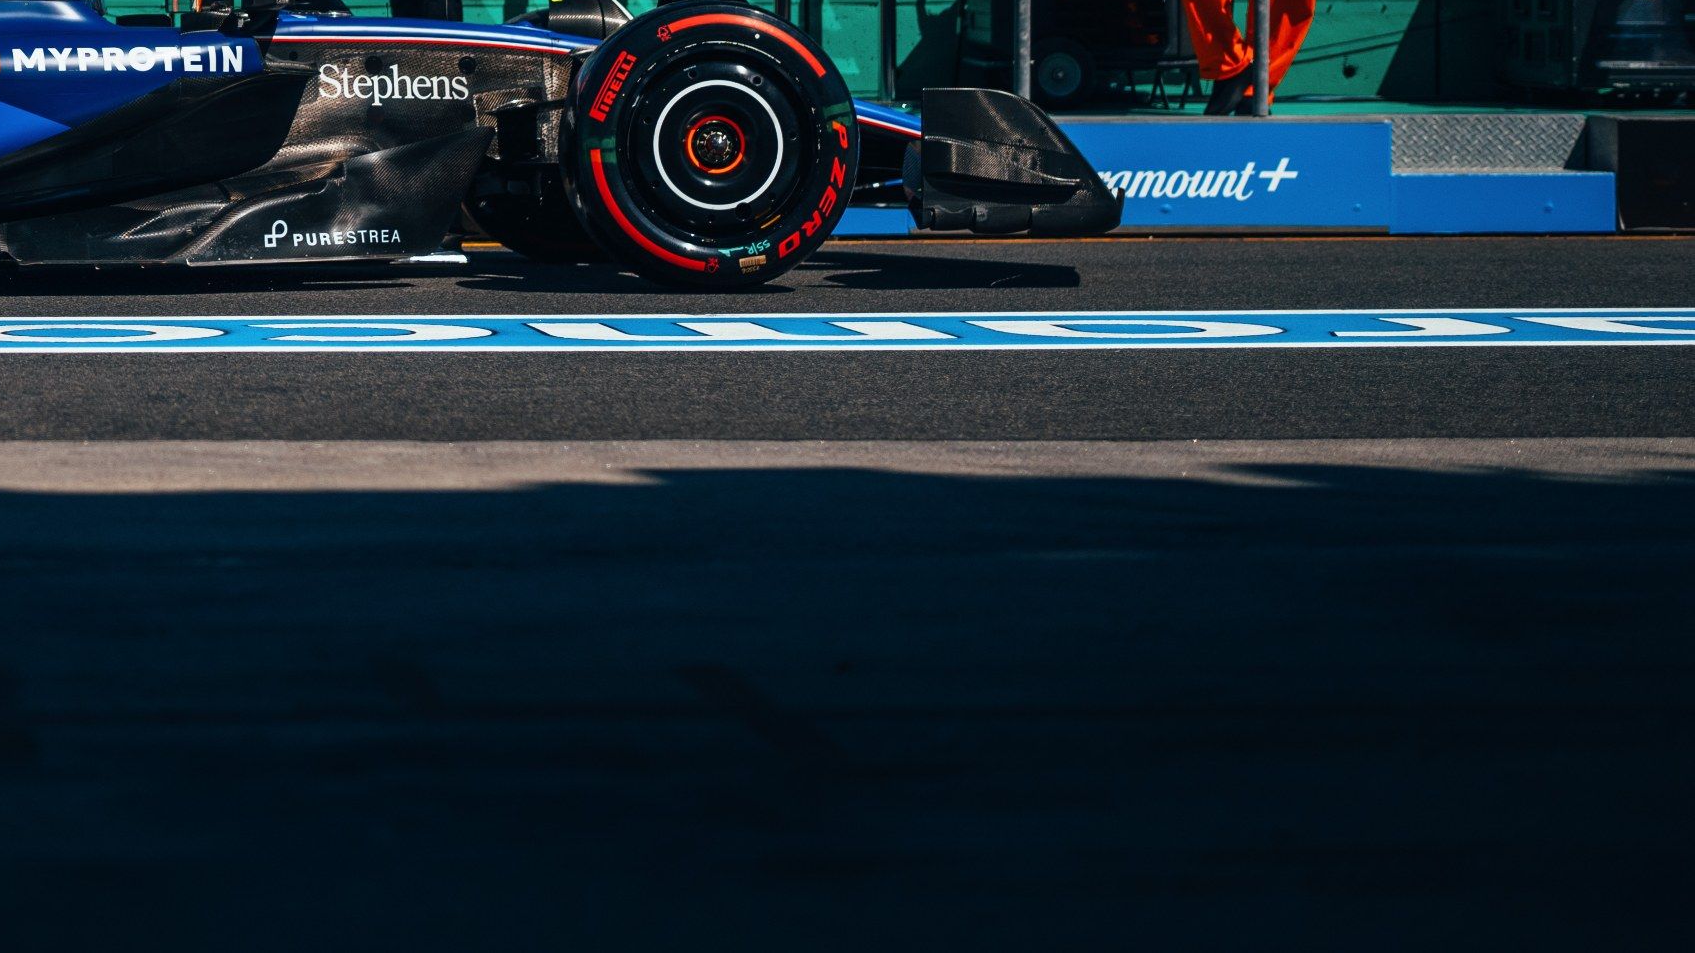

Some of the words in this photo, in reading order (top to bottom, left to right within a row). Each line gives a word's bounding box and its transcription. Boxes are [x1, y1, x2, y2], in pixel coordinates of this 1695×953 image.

[13, 45, 243, 73] MYPROTEIN
[318, 63, 469, 106] Stephens
[588, 49, 639, 123] PIRELLI
